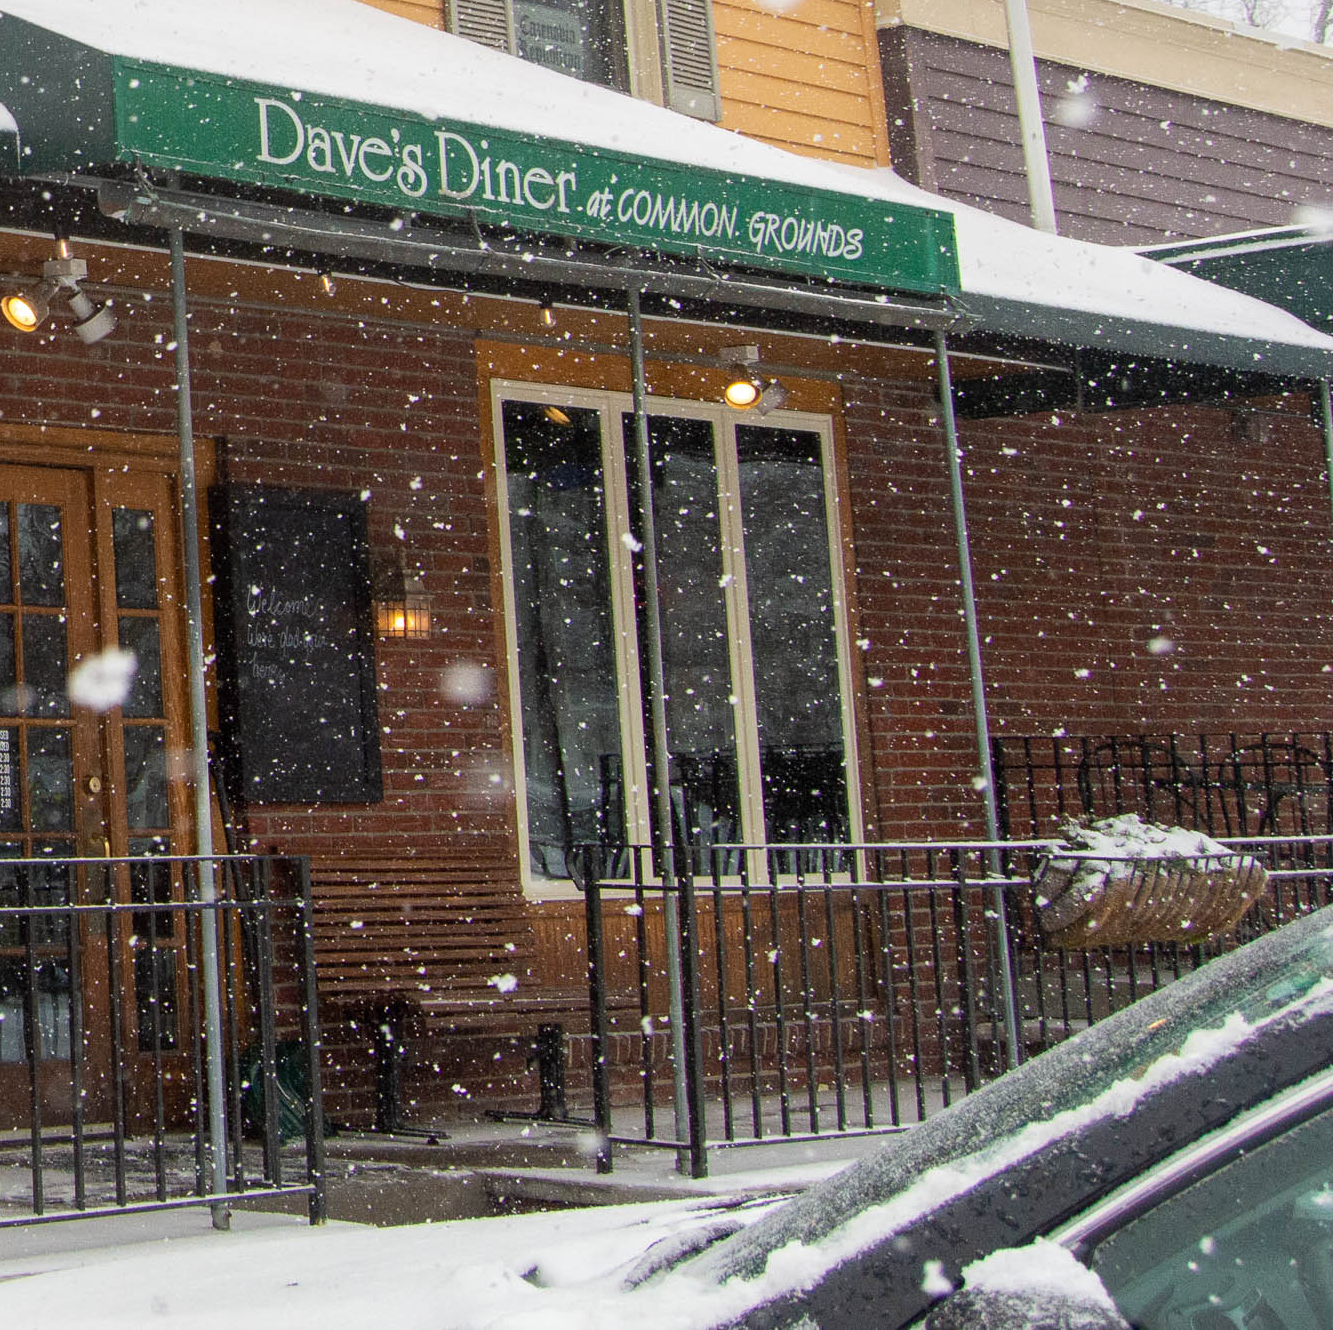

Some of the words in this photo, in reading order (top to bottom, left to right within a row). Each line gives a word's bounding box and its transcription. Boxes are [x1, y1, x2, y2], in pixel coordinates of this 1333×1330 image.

[520, 14, 575, 44] Cazenovia
[253, 96, 429, 199] Dave's
[434, 130, 577, 214] Diner
[586, 186, 614, 221] at
[617, 187, 738, 240] COMMON
[748, 210, 865, 260] GROUNDS
[246, 583, 319, 618] Welcome
